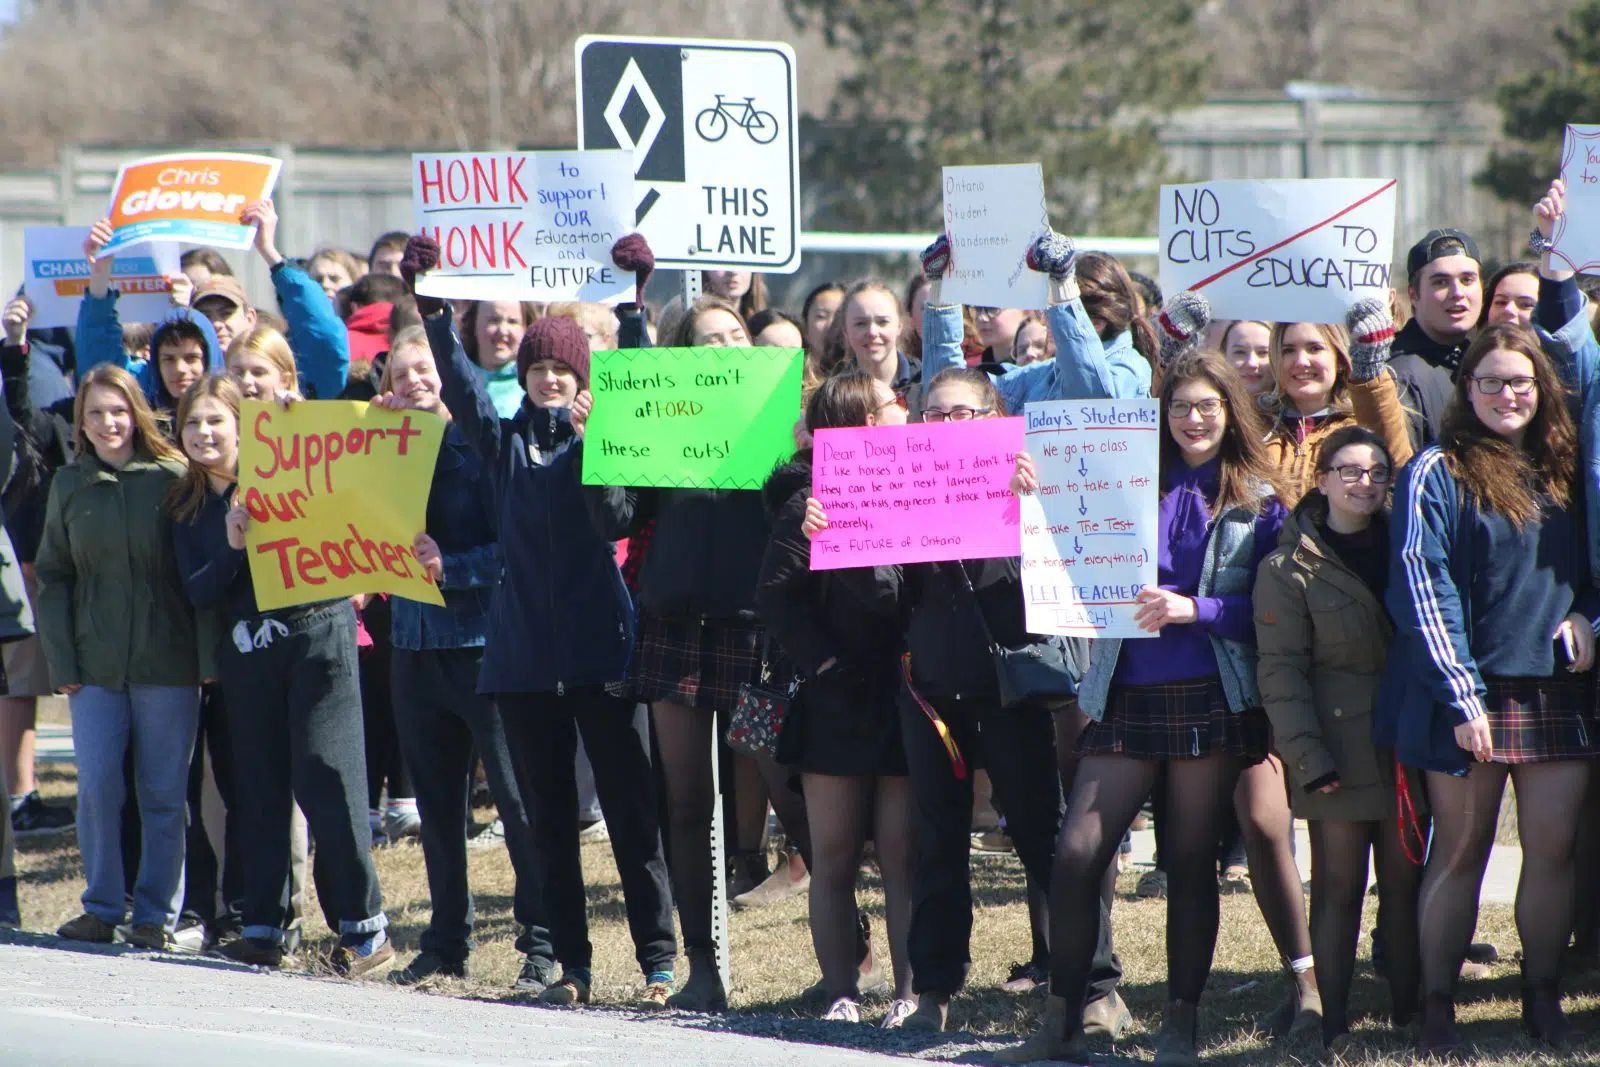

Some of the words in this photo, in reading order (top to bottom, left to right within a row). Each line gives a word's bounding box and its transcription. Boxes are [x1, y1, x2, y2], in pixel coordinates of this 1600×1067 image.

[157, 168, 220, 185] Chris
[420, 157, 528, 204] HONK
[559, 162, 579, 177] to
[1580, 167, 1598, 184] to
[537, 182, 606, 209] support
[946, 176, 985, 195] Ontario
[121, 187, 246, 216] Glover
[702, 186, 769, 217] THIS
[1174, 188, 1220, 226] NO
[554, 211, 592, 228] OUR
[947, 203, 988, 223] Student
[535, 230, 613, 246] Education
[696, 224, 776, 256] LANE
[1168, 229, 1256, 264] CUTS
[1333, 225, 1378, 254] TO
[558, 247, 586, 260] and
[39, 263, 91, 277] CHAN
[531, 265, 616, 288] FUTURE
[948, 253, 985, 285] Program
[1247, 257, 1392, 291] EDUCATION
[598, 370, 676, 392] Students
[695, 368, 744, 387] can't
[1026, 409, 1073, 435] Today's
[1080, 406, 1156, 424] Students:
[254, 410, 421, 496] Support
[600, 438, 651, 458] these
[683, 440, 731, 459] cuts!
[823, 441, 856, 462] Dear
[864, 440, 896, 462] Doug
[906, 437, 935, 453] Ford,
[1043, 442, 1058, 456] We
[1064, 444, 1078, 463] go
[1082, 440, 1095, 453] to
[1100, 440, 1128, 452] class
[819, 466, 828, 477] I
[834, 466, 851, 476] like
[858, 465, 891, 476] horses
[898, 466, 905, 475] a
[911, 462, 923, 473] lot
[934, 460, 951, 472] but
[958, 458, 966, 469] I
[972, 455, 1000, 469] don't
[820, 483, 841, 496] they
[848, 484, 866, 493] can
[872, 481, 883, 493] be
[889, 481, 904, 490] our
[913, 479, 938, 489] next
[947, 474, 990, 487] lawyers,
[1038, 482, 1061, 496] learn
[1066, 480, 1079, 493] to
[1084, 478, 1110, 491] take
[1116, 480, 1123, 489] a
[1129, 475, 1151, 487] test
[245, 487, 308, 523] our
[860, 498, 891, 510] artists,
[893, 497, 936, 511] engineers
[956, 492, 980, 502] stock
[824, 517, 873, 530] incerely,
[1024, 522, 1040, 535] We
[1046, 523, 1070, 534] take
[1076, 519, 1100, 533] The
[1104, 517, 1135, 531] Test
[817, 540, 841, 554] The
[849, 537, 894, 550] FUTURE
[901, 536, 912, 548] of
[921, 535, 962, 547] Ontario
[1043, 555, 1077, 571] forget
[1084, 547, 1149, 568] everything)
[1055, 607, 1114, 626] TEACH!
